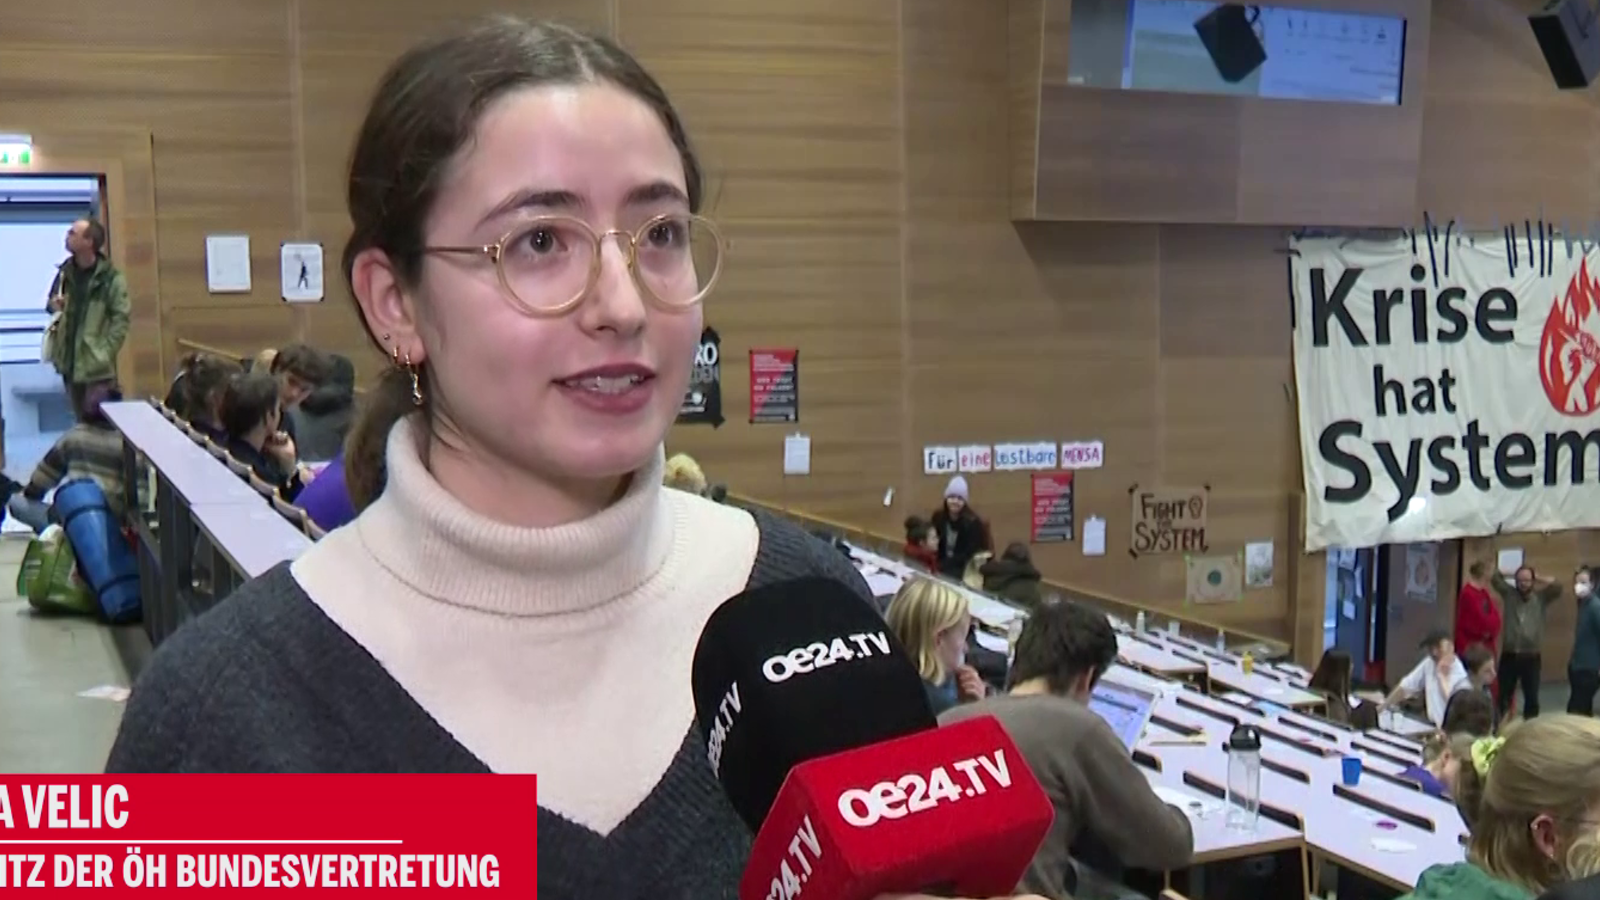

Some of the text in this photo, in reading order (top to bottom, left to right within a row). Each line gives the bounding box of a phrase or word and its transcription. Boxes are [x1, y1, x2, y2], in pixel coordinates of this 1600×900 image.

[1310, 264, 1518, 347] Krise
[1373, 364, 1456, 416] hat
[961, 451, 990, 467] eine
[1318, 419, 1600, 523] System
[762, 631, 891, 683] oe24.TV
[837, 748, 1013, 827] oe24.TV
